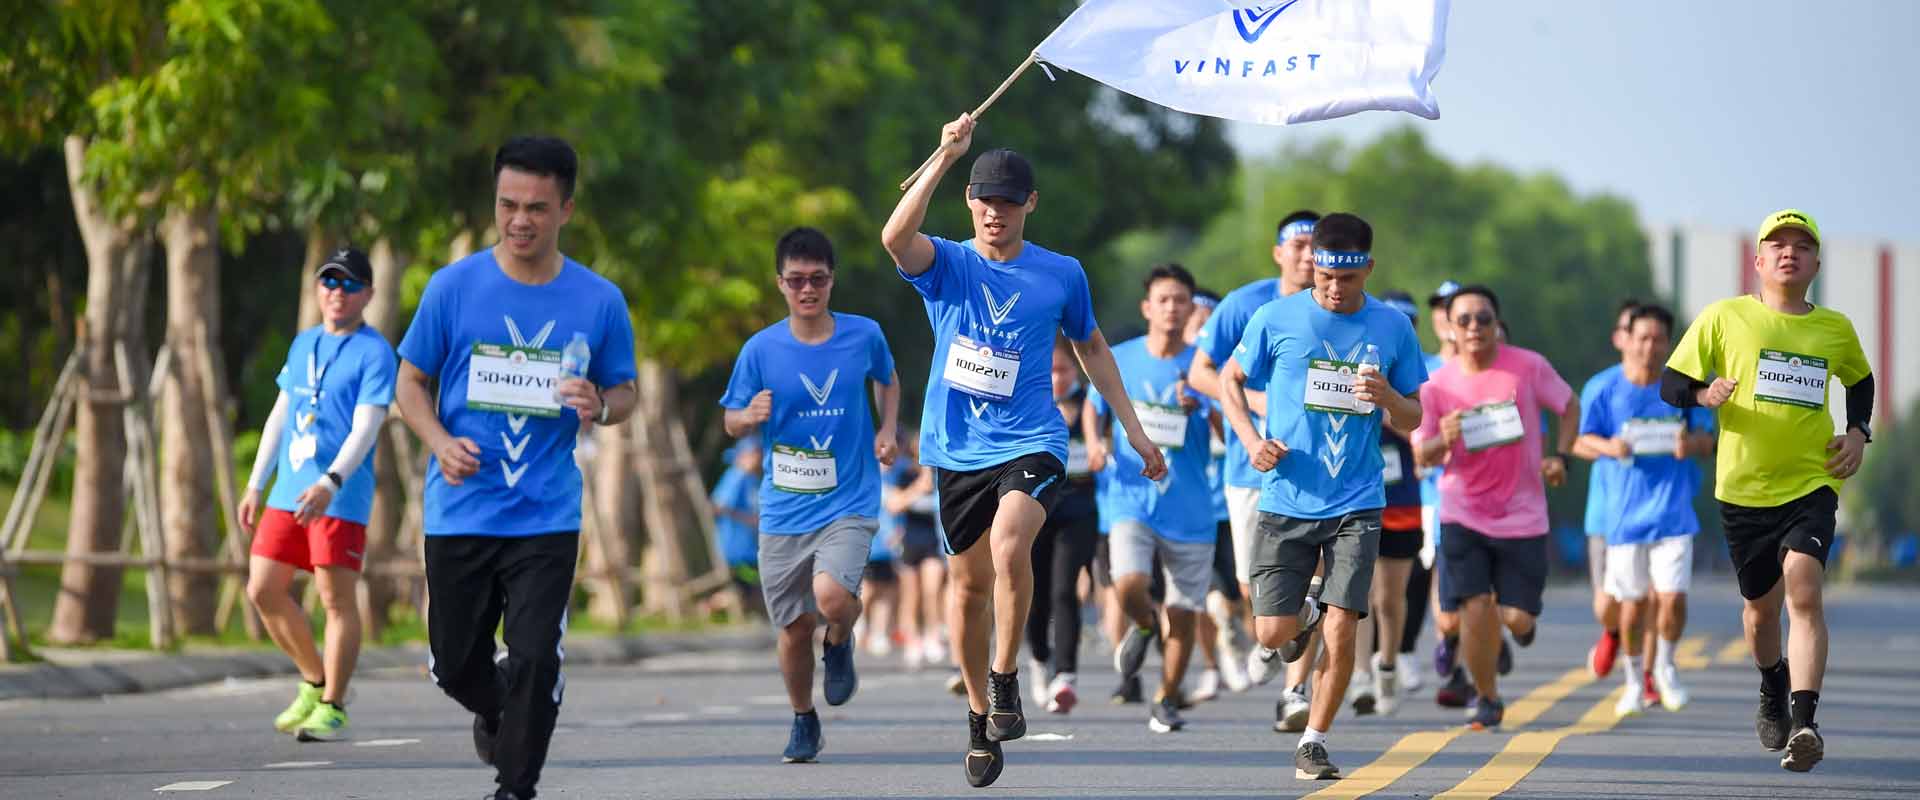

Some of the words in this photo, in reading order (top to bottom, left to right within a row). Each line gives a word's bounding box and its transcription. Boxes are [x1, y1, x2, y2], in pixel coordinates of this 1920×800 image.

[1174, 53, 1321, 78] VINFAST
[972, 321, 1019, 340] VINFAST
[955, 358, 1009, 380] 10022VF
[1312, 380, 1356, 394] 50302
[1759, 370, 1825, 389] 50024VCR
[797, 407, 846, 418] VINFAST
[776, 463, 830, 477] 50450VF
